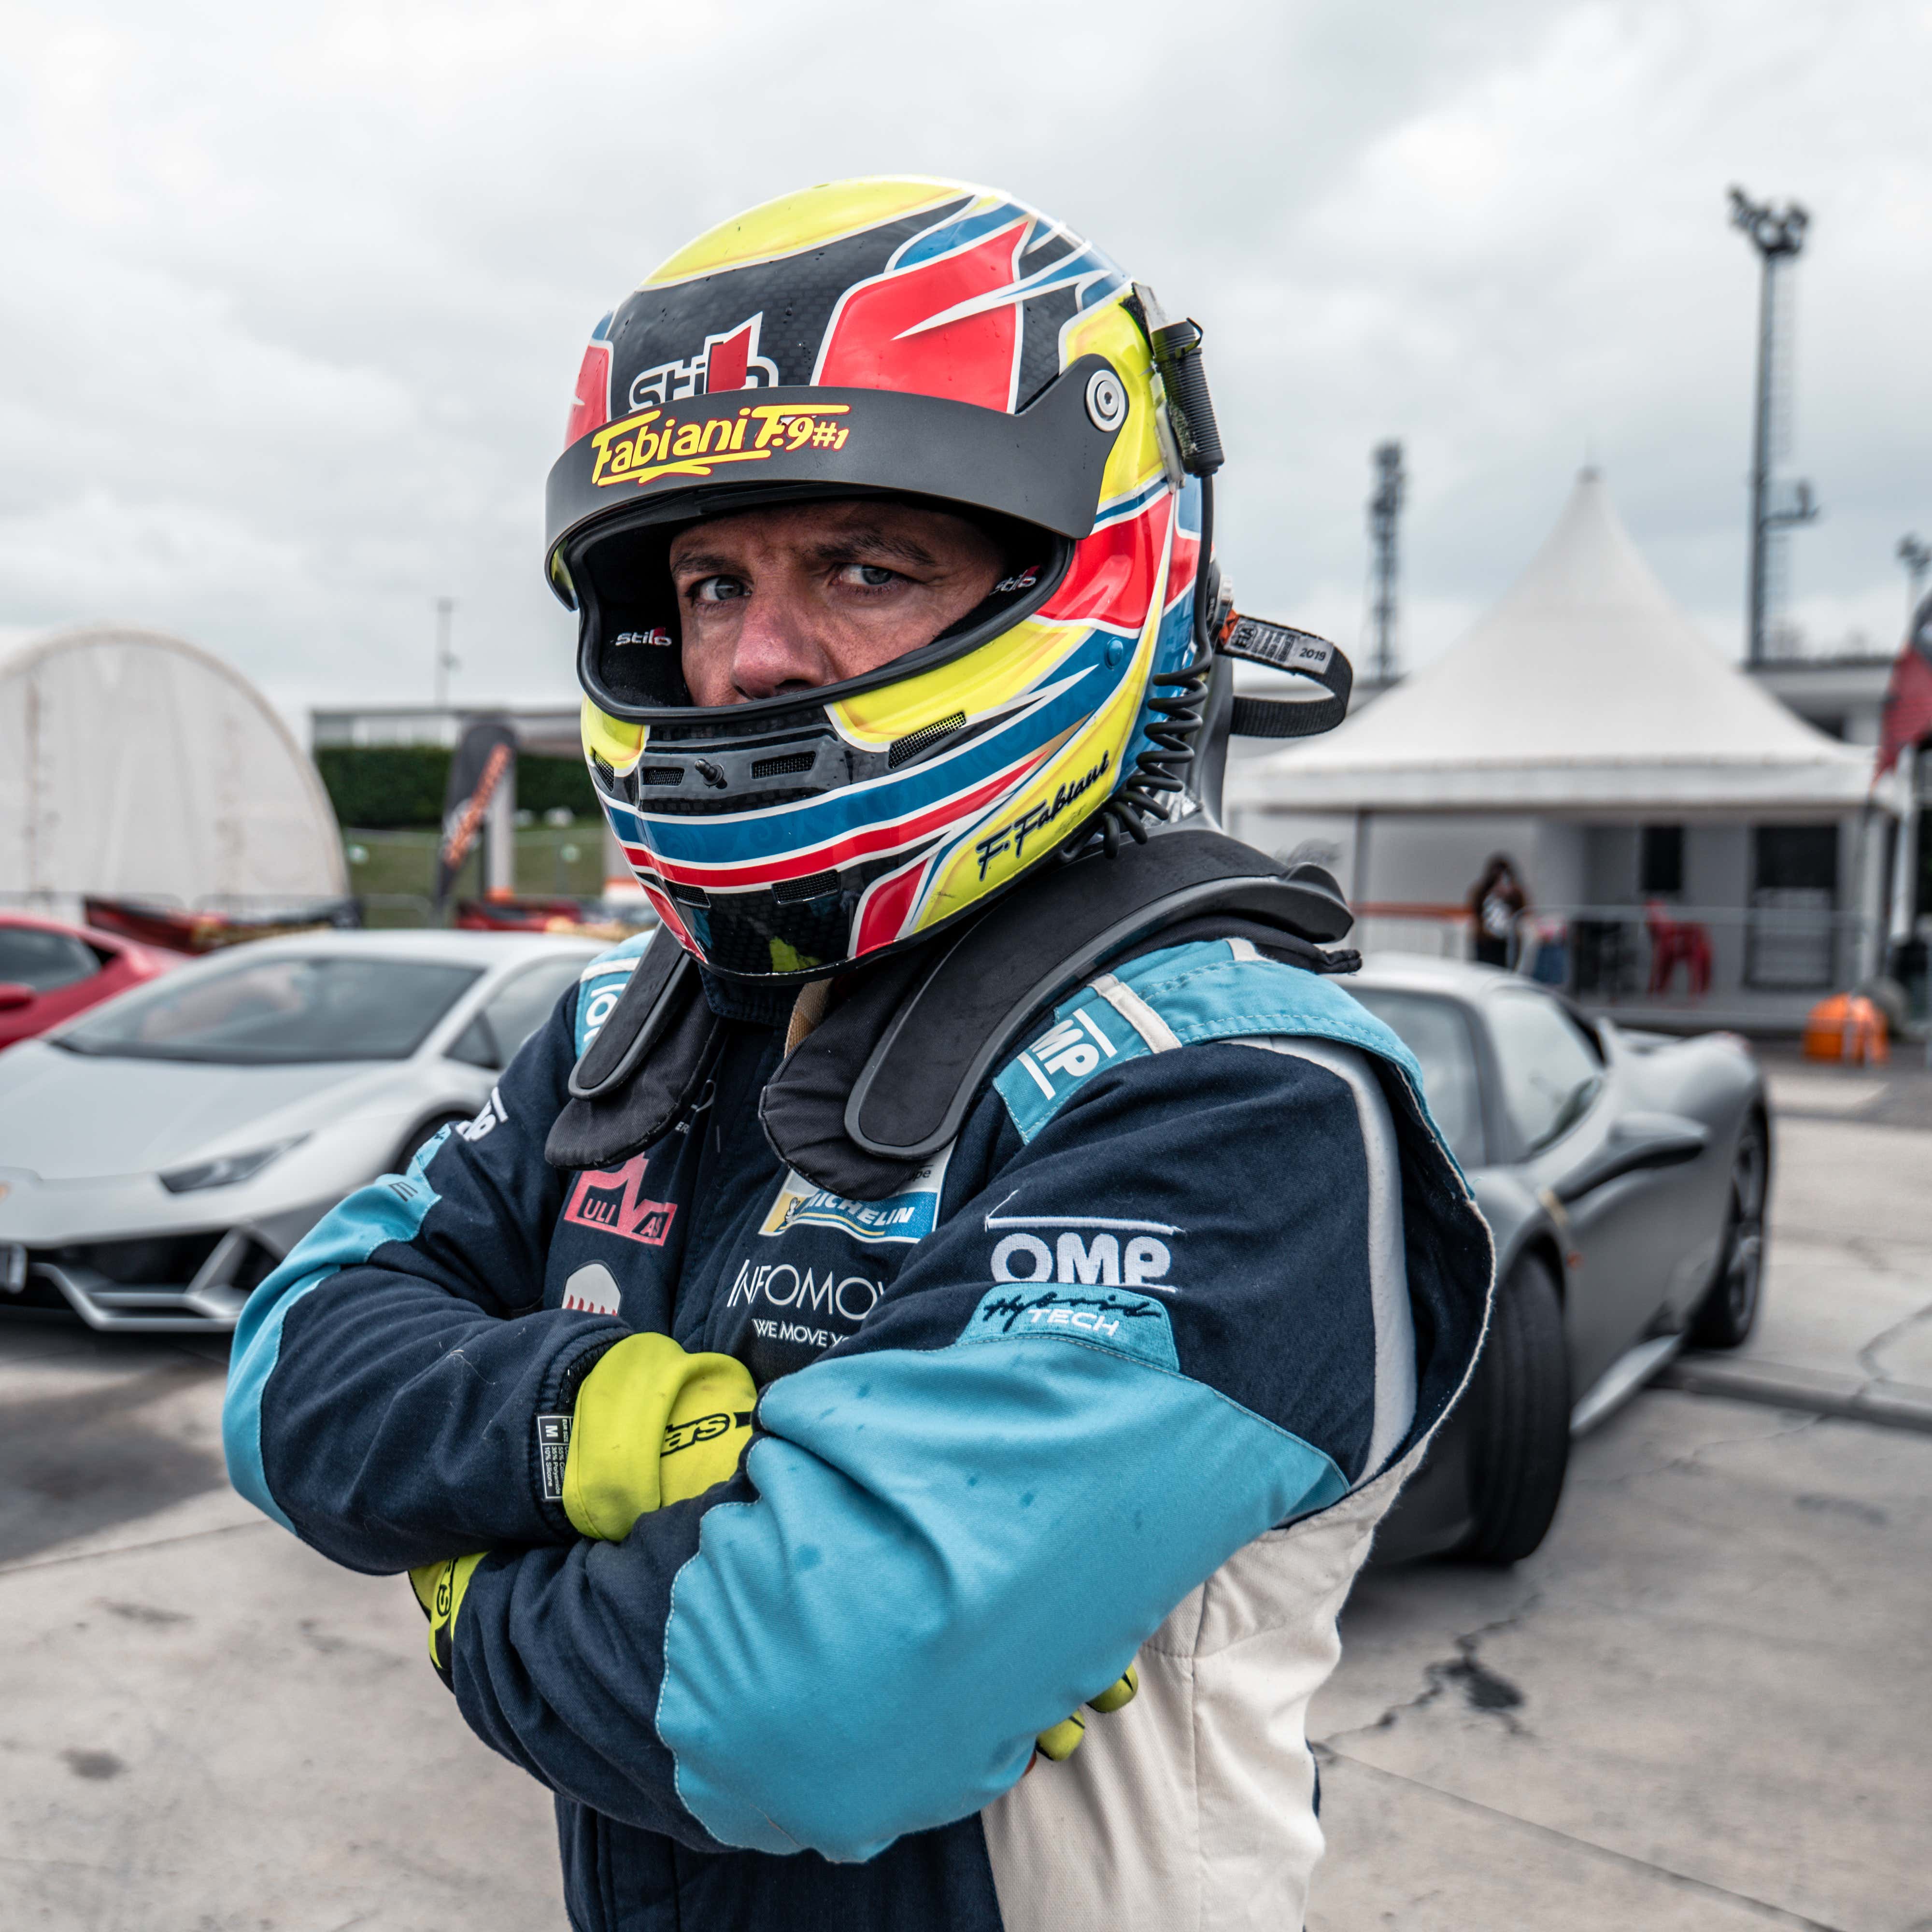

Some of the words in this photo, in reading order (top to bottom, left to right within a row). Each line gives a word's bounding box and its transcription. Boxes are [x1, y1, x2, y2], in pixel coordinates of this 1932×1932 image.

[592, 407, 752, 485] Fabiani
[1299, 648, 1327, 661] 2019
[1027, 1019, 1100, 1077] MP
[990, 1232, 1171, 1286] OMP
[752, 1318, 778, 1338] WE
[778, 1320, 828, 1348] MOVE
[1027, 1308, 1120, 1337] TECH
[545, 1425, 558, 1437] M
